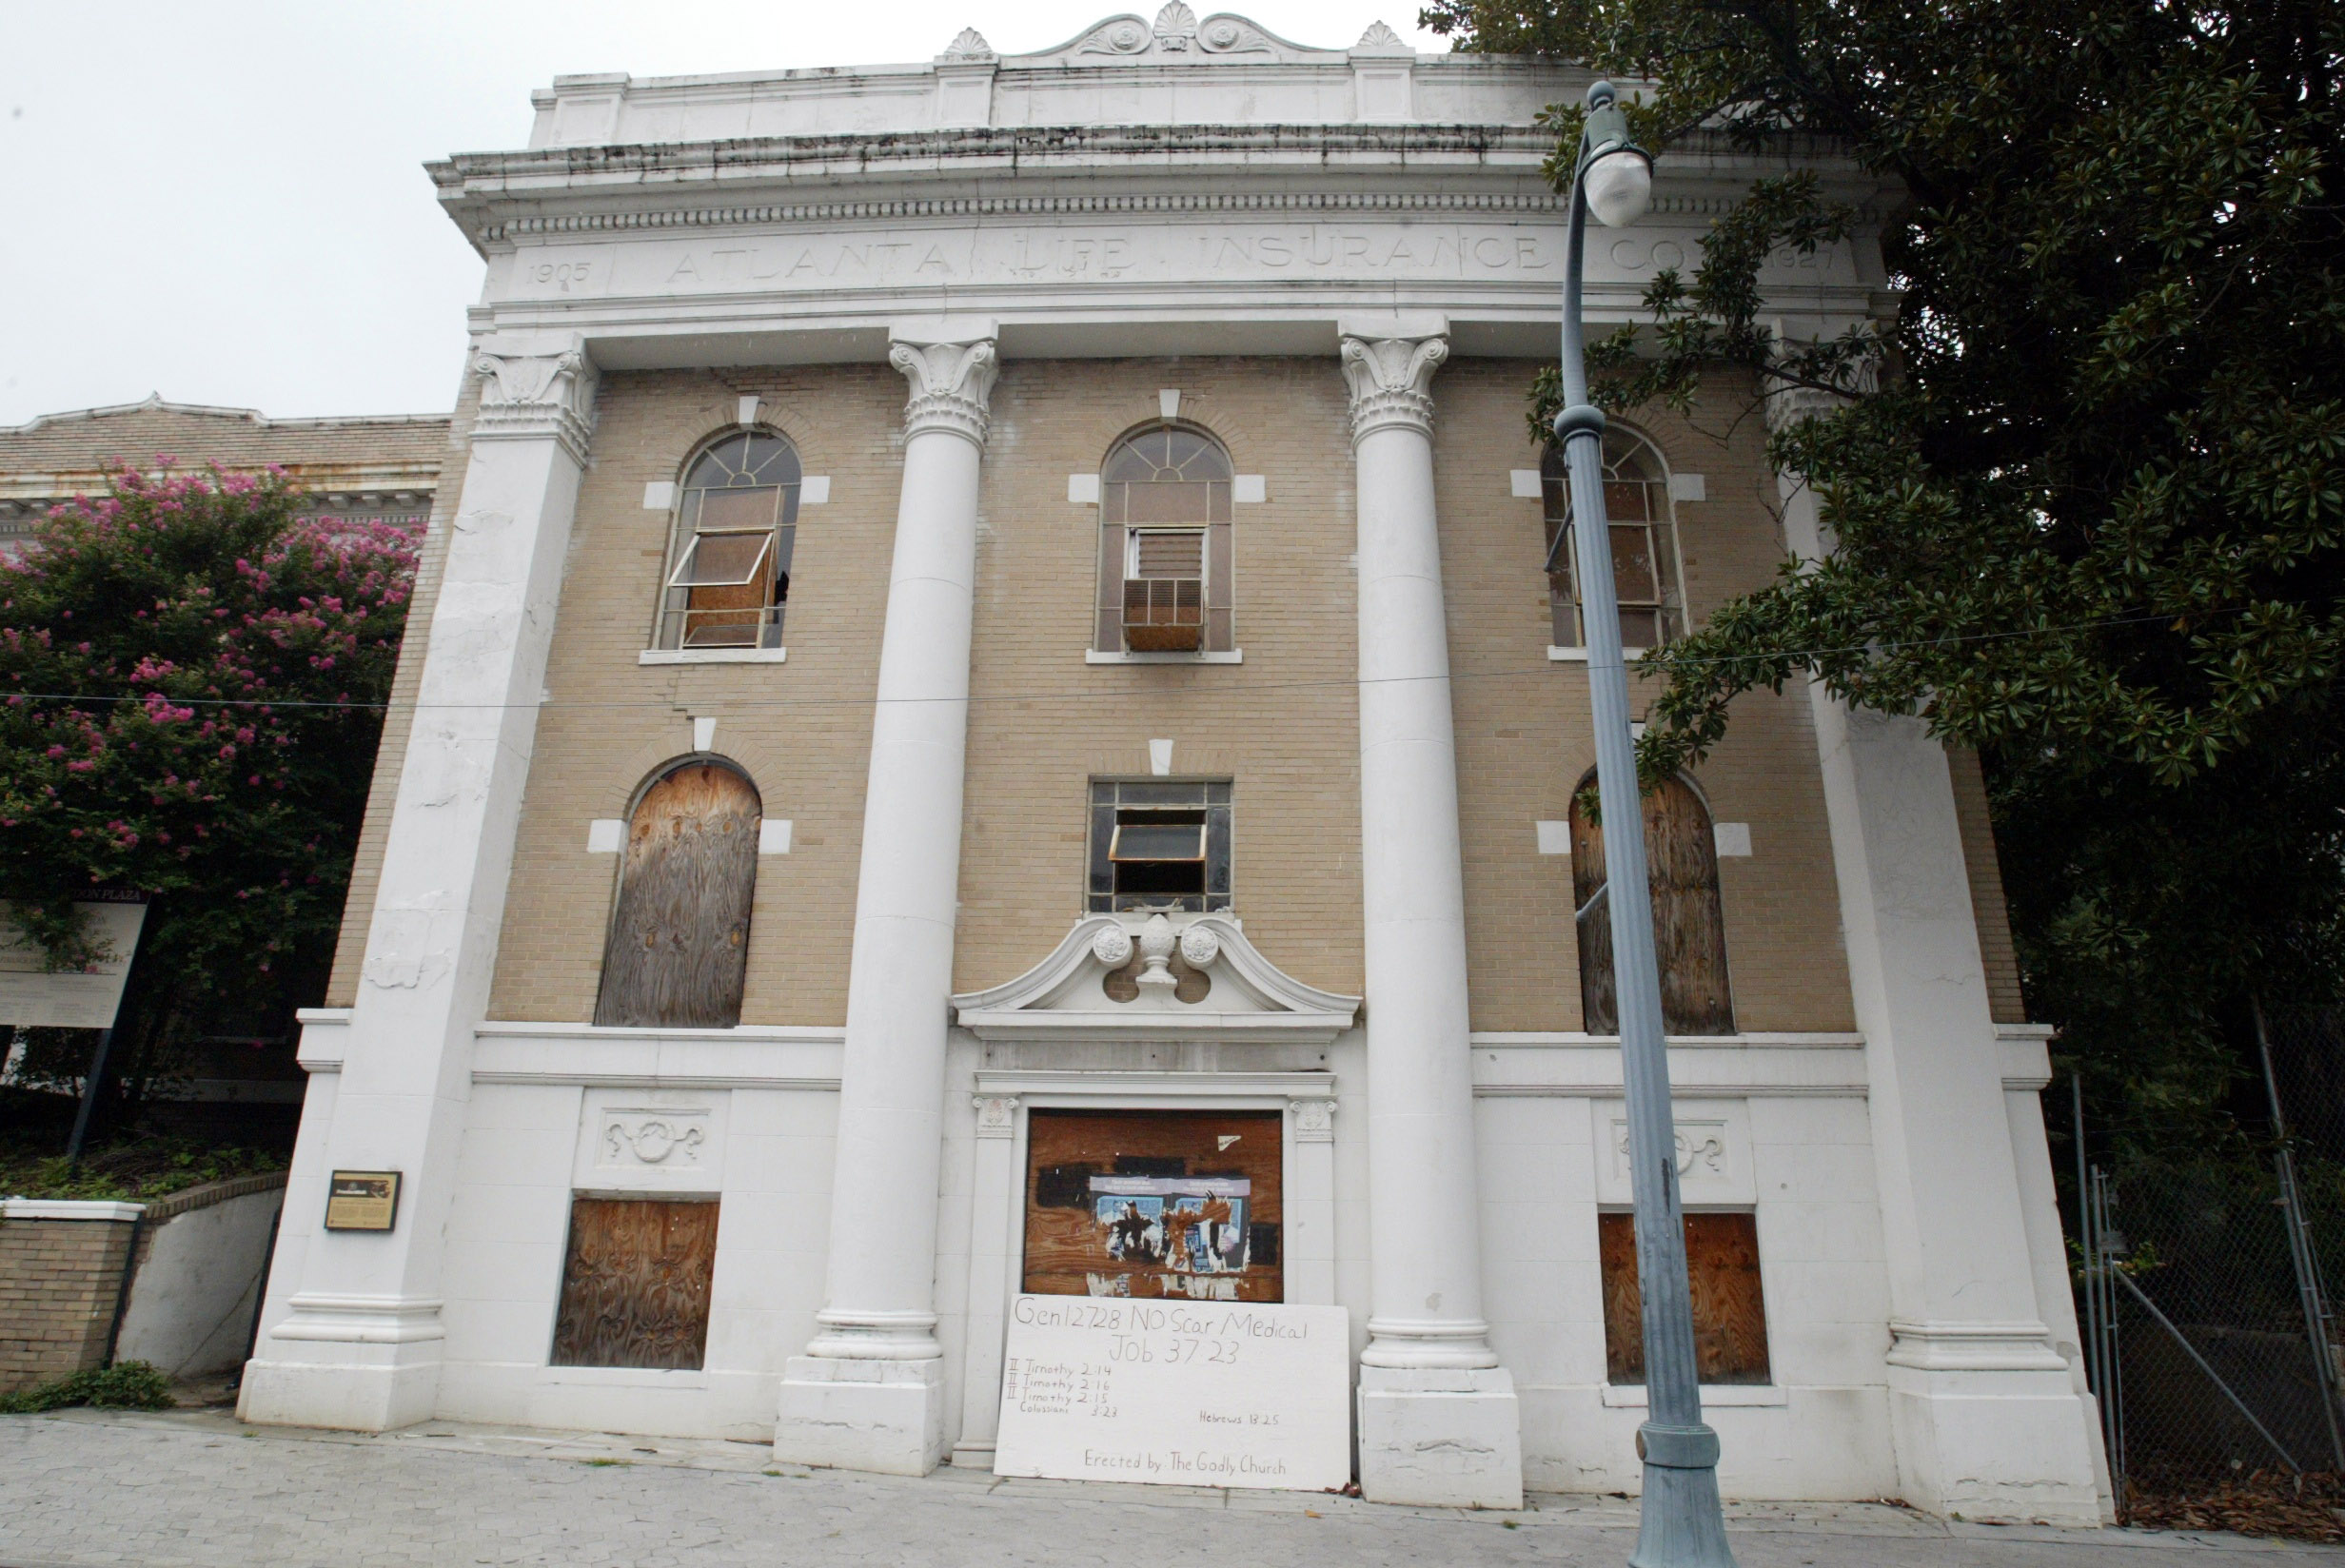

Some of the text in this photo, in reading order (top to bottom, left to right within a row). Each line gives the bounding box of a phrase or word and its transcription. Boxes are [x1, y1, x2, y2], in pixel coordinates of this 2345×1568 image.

[526, 262, 591, 284] 1905
[665, 243, 954, 283] ATLANTA
[1012, 239, 1136, 271] LIFE
[1194, 236, 1552, 269] INSURANCE
[1768, 248, 1834, 269] 1927
[1171, 1308, 1213, 1335] Scar
[1220, 1312, 1309, 1340] Medical
[1025, 1358, 1074, 1379] Timothy
[1023, 1373, 1074, 1394] Timothy
[1021, 1386, 1072, 1406] Timothy
[1198, 1409, 1242, 1425] Hebrews
[1084, 1449, 1141, 1469] Erected
[1170, 1451, 1192, 1471] The
[1196, 1451, 1235, 1477] Godly
[1239, 1454, 1287, 1475] Church
